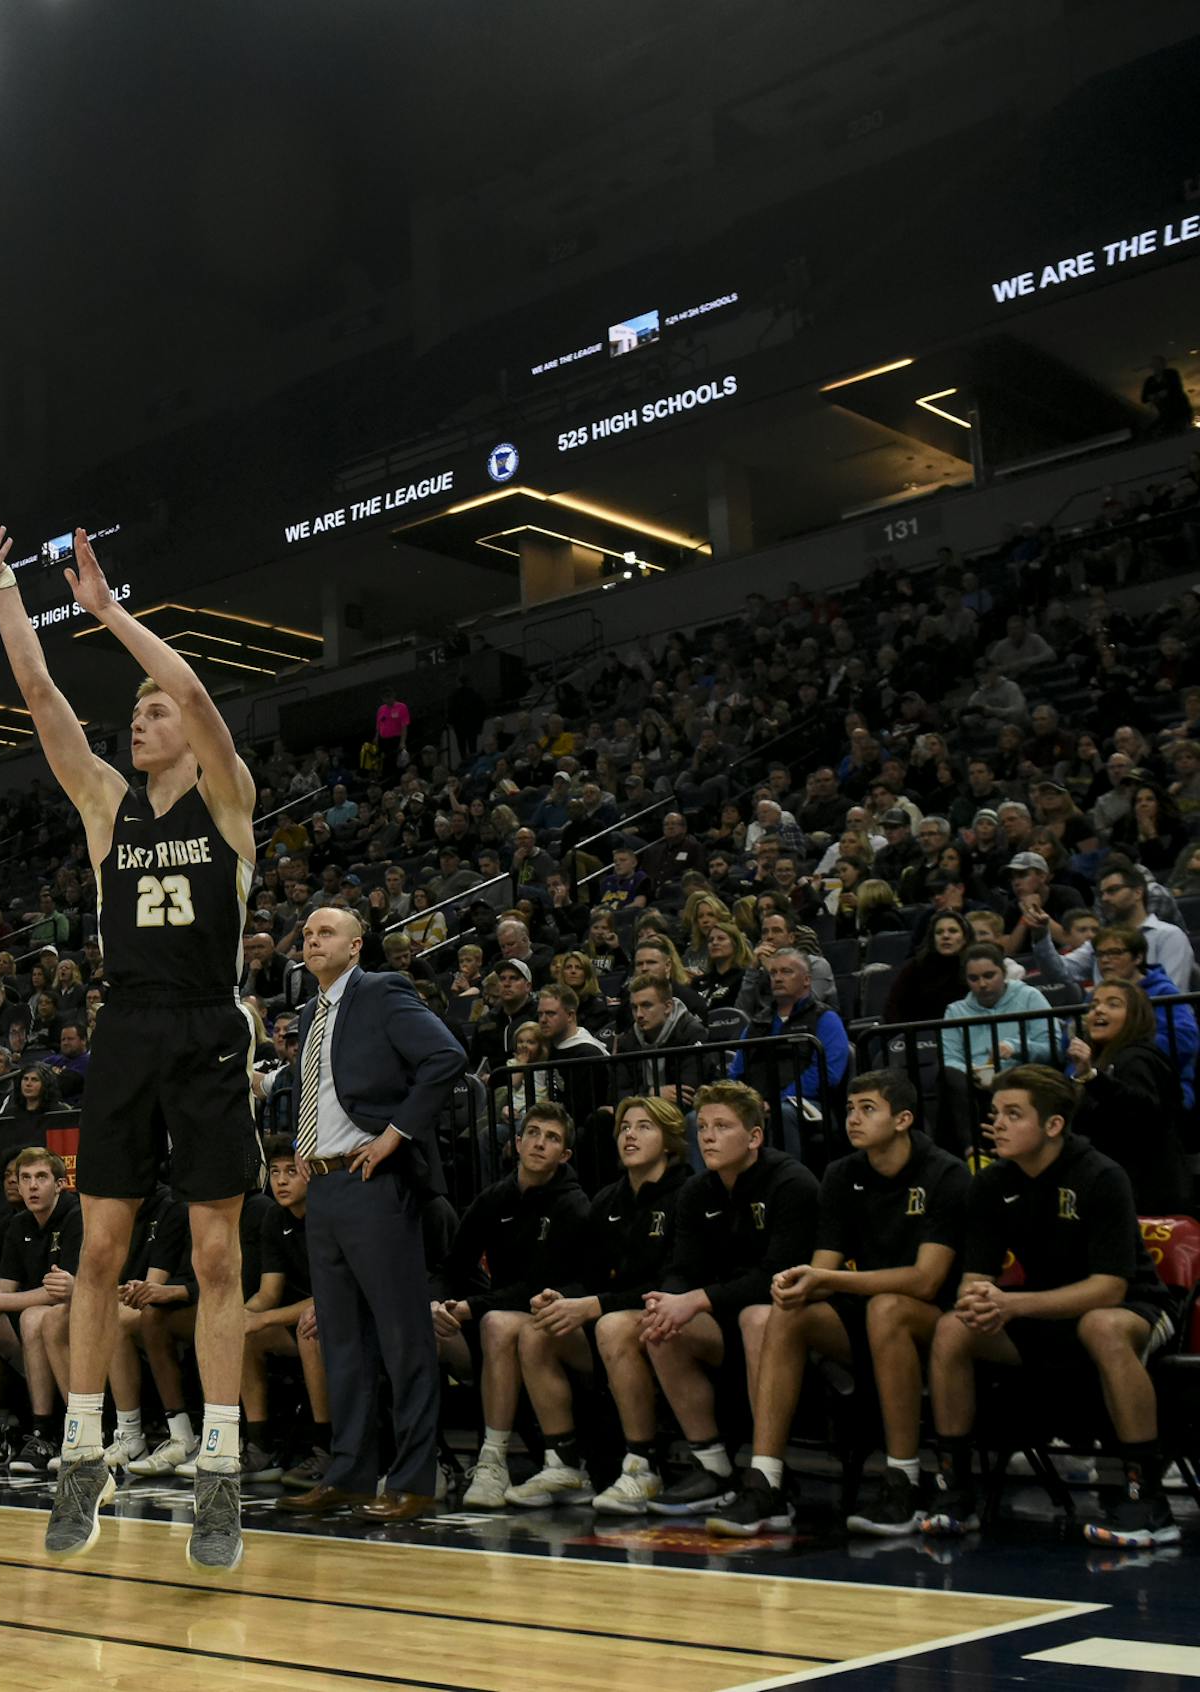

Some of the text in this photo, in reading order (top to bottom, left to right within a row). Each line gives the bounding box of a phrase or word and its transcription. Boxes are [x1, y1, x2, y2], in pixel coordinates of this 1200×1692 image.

[991, 215, 1200, 303] WE ARE THE LE
[531, 342, 603, 376] WE ARE THE LEAGUE
[557, 375, 738, 452] 525 HIGH SCHOOLS
[284, 471, 454, 543] WE ARE THE LEAGUE
[883, 517, 918, 541] 131
[41, 604, 70, 627] HIGH
[155, 836, 213, 868] RIDGE
[136, 874, 196, 927] 23
